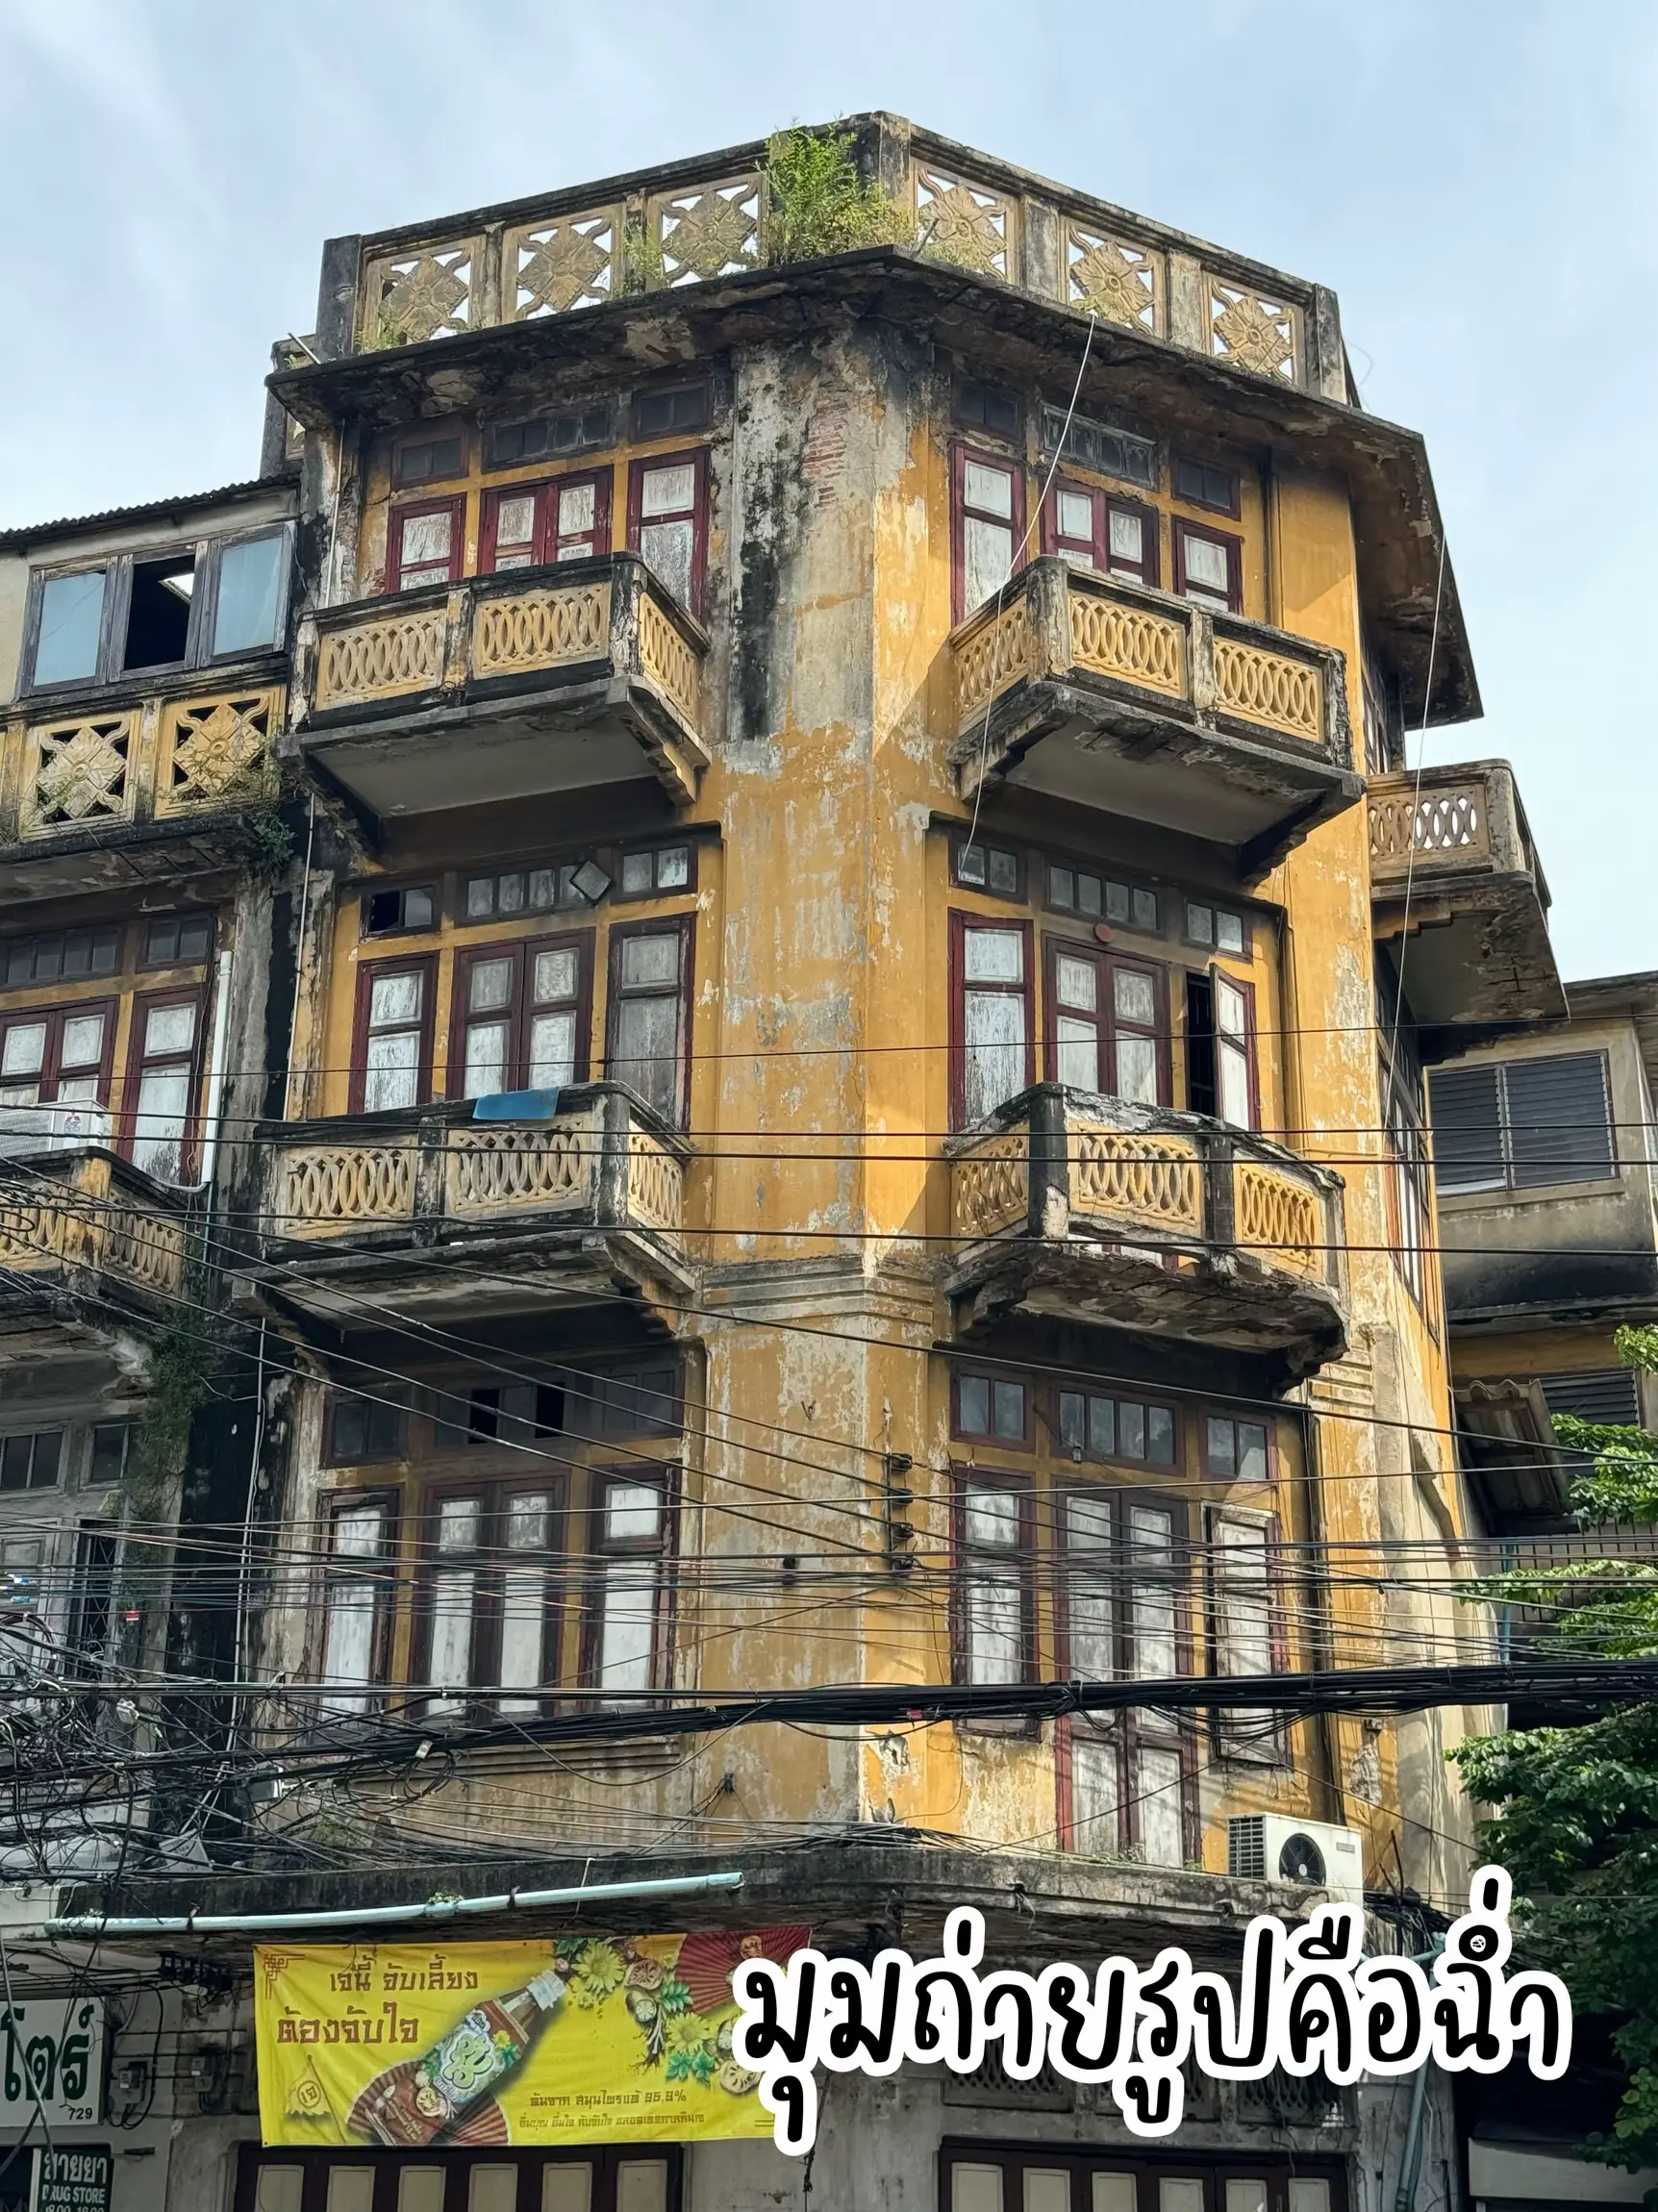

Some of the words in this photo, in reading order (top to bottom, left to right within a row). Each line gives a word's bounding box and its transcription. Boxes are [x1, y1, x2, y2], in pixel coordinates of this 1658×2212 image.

[330, 1954, 372, 1992] เจนี้
[383, 1953, 479, 1991] จับเลี้ยง
[276, 2000, 419, 2044] ต้องจับใจ
[68, 2107, 92, 2120] 729
[72, 2186, 106, 2204] STORE
